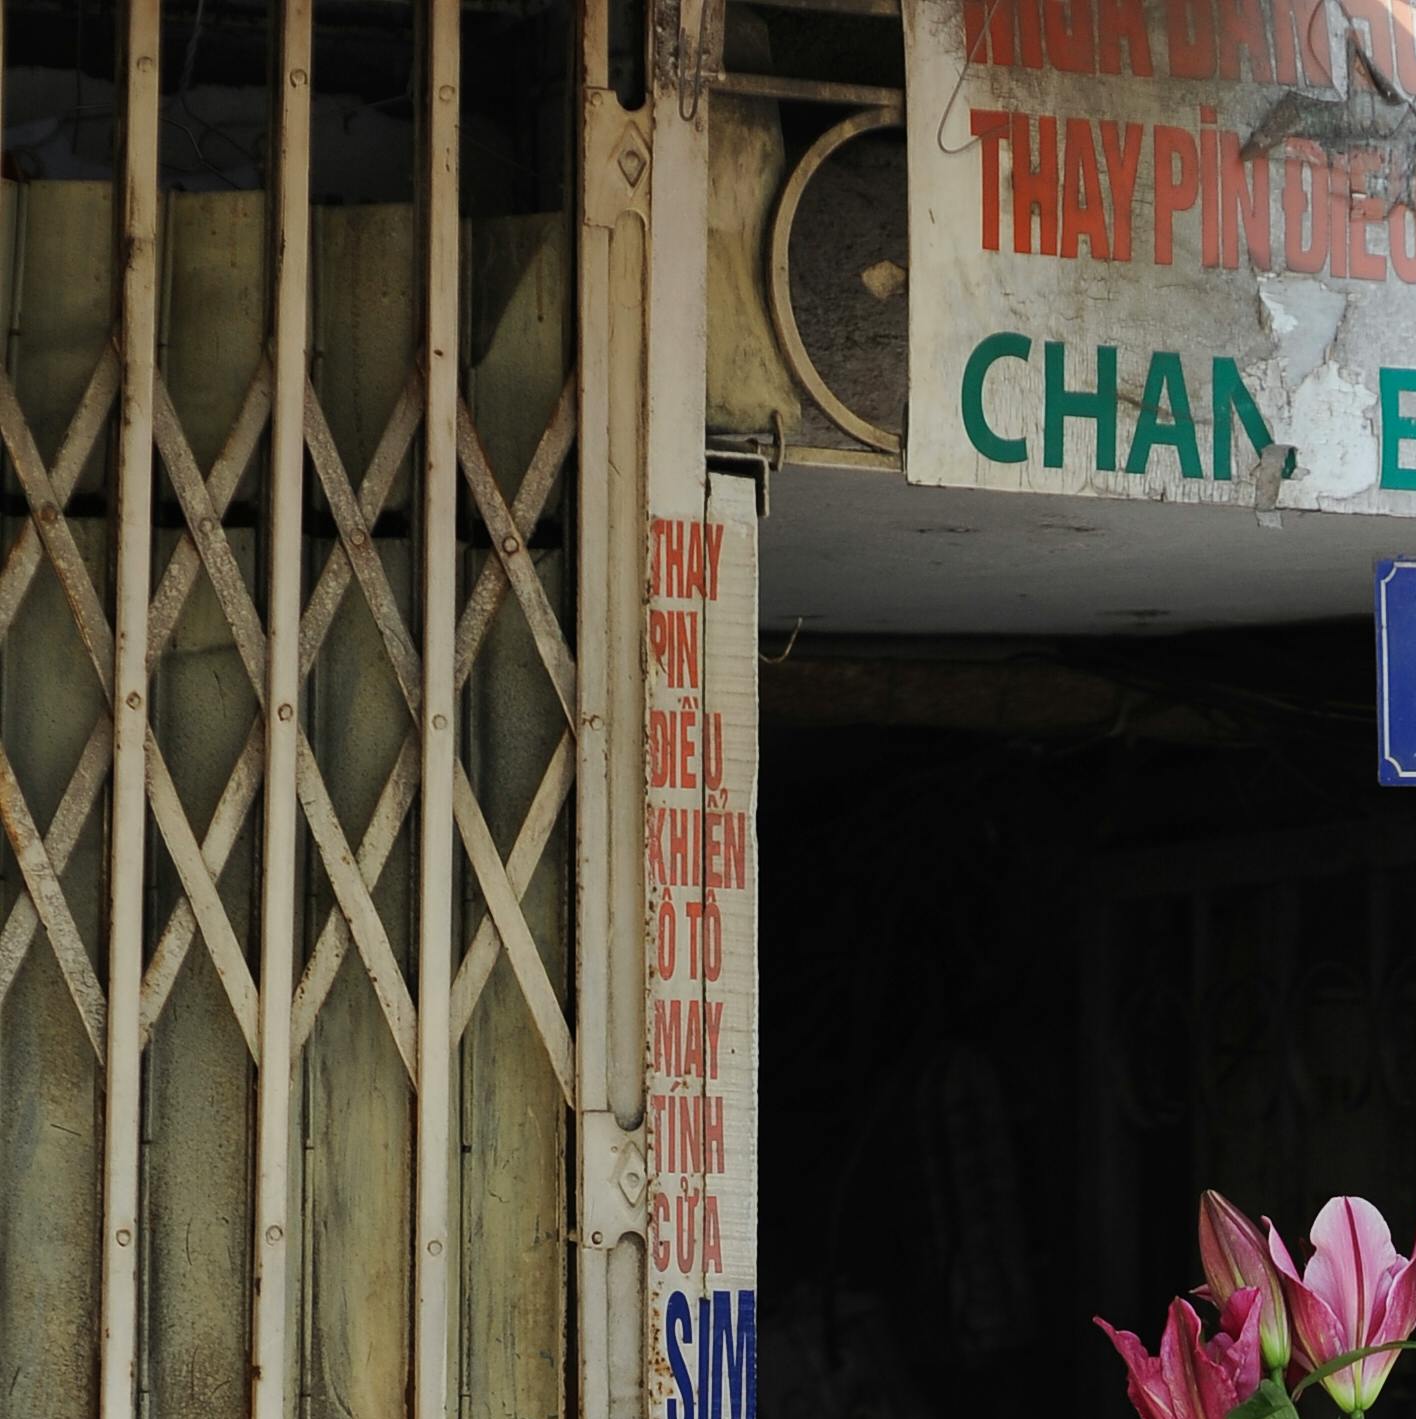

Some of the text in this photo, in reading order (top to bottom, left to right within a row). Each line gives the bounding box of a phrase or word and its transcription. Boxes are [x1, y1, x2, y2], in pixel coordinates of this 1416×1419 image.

[969, 108, 1145, 263] THAY
[650, 519, 725, 602] THAY
[650, 609, 699, 690] PIN
[651, 1080, 726, 1175] TÍNH
